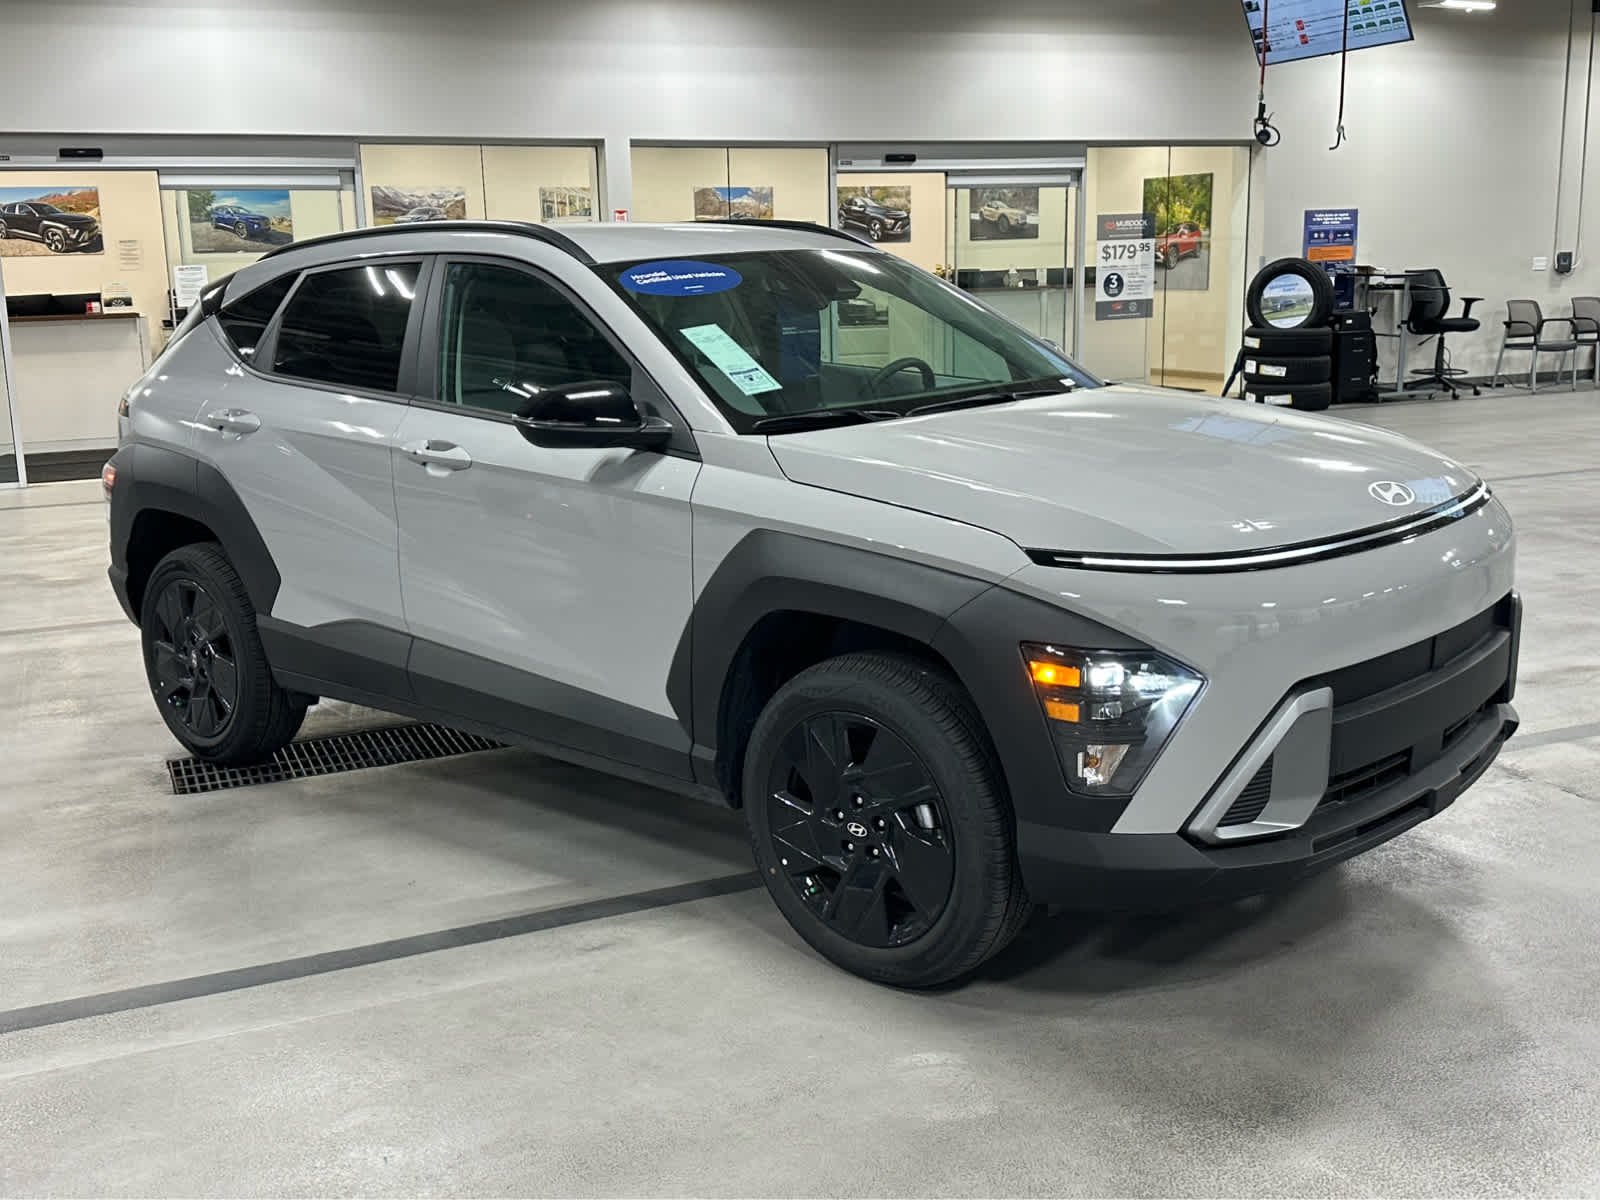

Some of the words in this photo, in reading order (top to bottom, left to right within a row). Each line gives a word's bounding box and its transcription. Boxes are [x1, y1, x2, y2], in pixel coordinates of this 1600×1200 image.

[630, 271, 667, 280] Hyundai
[636, 276, 673, 285] Certified
[1109, 275, 1118, 288] 3
